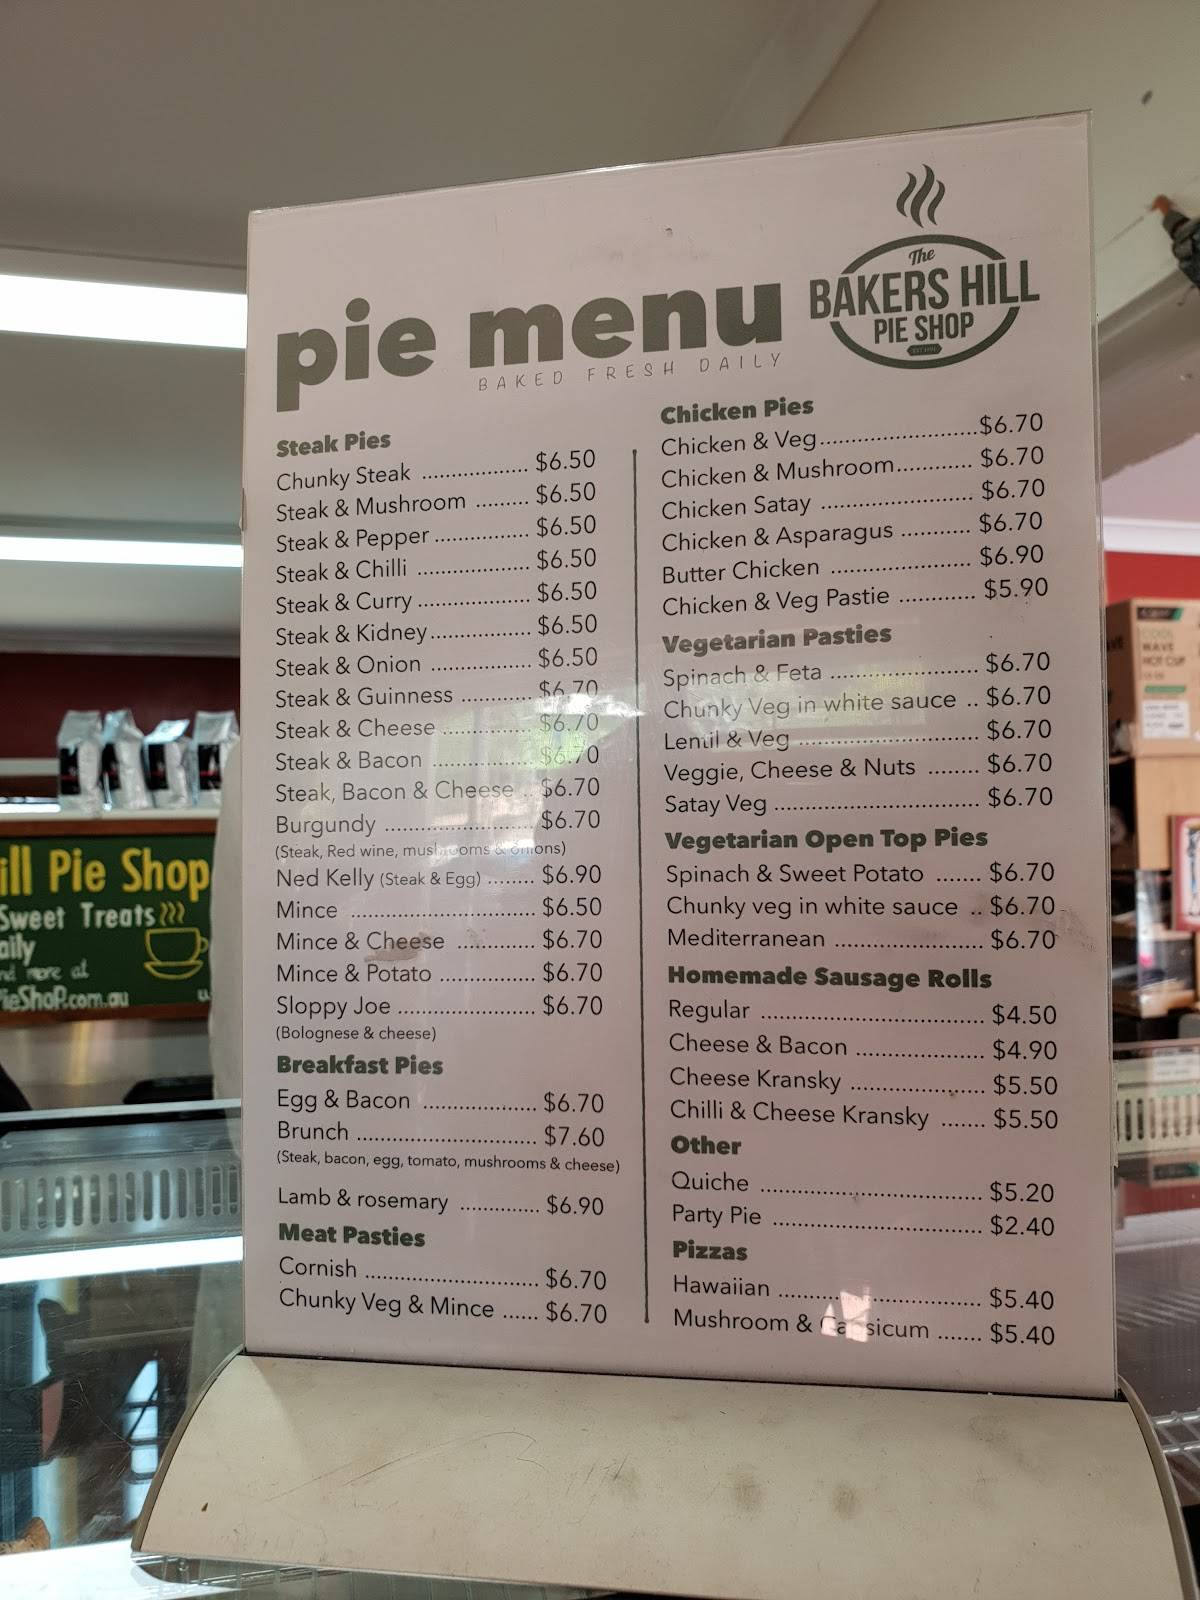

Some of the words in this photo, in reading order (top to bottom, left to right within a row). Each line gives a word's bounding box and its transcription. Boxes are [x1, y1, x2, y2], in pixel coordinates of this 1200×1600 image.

[908, 248, 936, 266] The
[809, 267, 949, 319] BAKERS
[960, 260, 1040, 307] HILL
[874, 317, 908, 344] PIE
[914, 312, 974, 341] SHOP
[277, 297, 436, 412] pie
[470, 283, 782, 369] menu
[478, 370, 563, 391] BAKED
[588, 360, 674, 382] FRESH
[700, 352, 782, 373] DAILY
[660, 402, 756, 424] Chicken
[764, 396, 814, 417] Pies
[276, 435, 338, 457] Steak
[345, 431, 391, 451] Pies
[662, 435, 745, 456] Chicken
[753, 432, 768, 450] &
[775, 430, 816, 452] Veg
[980, 412, 1043, 436] $6.70
[277, 468, 350, 491] Chunky
[356, 462, 411, 484] Steak
[536, 449, 595, 473] $6.50
[276, 500, 329, 522] Steak
[335, 499, 349, 517] &
[357, 494, 465, 516] Mushroom
[536, 482, 595, 506] $6.50
[662, 498, 746, 520] Chicken
[754, 496, 811, 516] Satay
[982, 478, 1045, 501] $6.70
[277, 531, 328, 553] Steak
[335, 530, 349, 548] &
[357, 529, 429, 551] Pepper
[536, 514, 596, 538] $6.50
[662, 530, 746, 552] Chicken
[754, 528, 770, 546] &
[776, 525, 893, 548] Asparagus
[979, 511, 1042, 534] $6.70
[663, 566, 726, 584] Butter
[733, 558, 819, 579] Chicken
[980, 544, 1043, 567] $6.90
[663, 594, 746, 616] Chicken
[755, 592, 770, 610] &
[776, 591, 818, 613] Veg
[827, 589, 889, 607] Pastie
[984, 577, 1048, 600] $5.90
[662, 629, 795, 657] Vegetarian
[804, 624, 892, 646] Pasties
[275, 656, 330, 677] Steak
[336, 656, 351, 675] &
[357, 655, 420, 674] Onion
[538, 647, 597, 669] $6.50
[664, 764, 743, 786] Veggie,
[751, 760, 832, 779] Cheese
[840, 758, 856, 777] &
[865, 757, 915, 776] Nuts
[988, 753, 1052, 775] $6.70
[665, 795, 720, 817] Satay
[726, 794, 766, 816] Veg
[988, 786, 1053, 808] $6.70
[277, 813, 376, 838] Burgundy
[541, 809, 600, 830] $6.70
[664, 829, 798, 854] Vegetarian
[805, 830, 874, 853] Open
[880, 829, 927, 852] Top
[935, 826, 988, 846] Pies
[49, 848, 106, 893] Pie
[121, 848, 210, 902] Shop
[277, 868, 318, 887] Ned
[327, 867, 374, 891] Kelly
[380, 872, 425, 888] (Steak
[430, 872, 441, 885] &
[446, 871, 480, 888] Egg)
[543, 864, 601, 885] $6.90
[667, 864, 749, 888] Spinach
[757, 864, 772, 882] &
[779, 864, 846, 882] Sweet
[854, 864, 923, 882] Potato
[990, 860, 1054, 883] $6.70
[0, 904, 65, 931] Sweet
[80, 902, 156, 928] Treats
[277, 900, 337, 918] Mince
[543, 896, 601, 918] $6.50
[667, 896, 746, 919] Chunky
[752, 902, 791, 919] veg
[800, 902, 817, 914] in
[825, 896, 885, 915] white
[893, 902, 958, 915] sauce
[990, 895, 1055, 917] $6.70
[668, 928, 824, 947] Mediterranean
[991, 928, 1055, 951] $6.70
[668, 966, 807, 985] Homemade
[814, 967, 920, 992] Sausage
[928, 968, 992, 989] Rolls
[277, 995, 347, 1020] Sloppy
[354, 996, 390, 1014] Joe
[543, 994, 602, 1016] $6.70
[669, 999, 750, 1023] Regular
[992, 1003, 1056, 1026] $4.50
[276, 1025, 359, 1043] (Bolognese
[364, 1026, 374, 1039] &
[379, 1025, 436, 1042] cheese)
[277, 1054, 389, 1074] Breakfast
[395, 1054, 443, 1075] Pies
[670, 1066, 750, 1087] Cheese
[758, 1069, 841, 1095] Kransky
[993, 1074, 1057, 1096] $5.50
[278, 1089, 317, 1113] Egg
[324, 1089, 339, 1108] &
[347, 1090, 409, 1109] Bacon
[544, 1091, 604, 1113] $6.70
[671, 1099, 722, 1119] Chilli
[731, 1101, 746, 1120] &
[753, 1101, 835, 1123] Cheese
[843, 1105, 929, 1131] Kransky
[994, 1107, 1058, 1130] $5.50
[278, 1120, 348, 1141] Brunch
[545, 1124, 604, 1147] $7.60
[671, 1135, 741, 1155] Other
[277, 1150, 320, 1166] (Steak,
[325, 1151, 369, 1166] bacon,
[373, 1156, 403, 1171] egg,
[408, 1155, 460, 1168] tomato,
[464, 1155, 546, 1169] mushrooms
[550, 1156, 560, 1170] &
[565, 1157, 619, 1174] cheese)
[279, 1187, 331, 1206] Lamb
[337, 1188, 351, 1206] &
[358, 1195, 448, 1215] rosemary
[547, 1194, 604, 1215] $6.90
[672, 1171, 748, 1191] Quiche
[990, 1181, 1054, 1203] $5.20
[279, 1223, 337, 1243] Meat
[343, 1226, 425, 1247] Pasties
[673, 1204, 723, 1229] Party
[731, 1206, 761, 1225] Pie
[990, 1214, 1054, 1236] $2.40
[673, 1239, 748, 1261] Pizzas
[279, 1256, 356, 1278] Cornish
[546, 1267, 606, 1290] $6.70
[280, 1288, 356, 1315] Chunky
[361, 1292, 401, 1318] Veg
[409, 1294, 424, 1314] &
[431, 1296, 494, 1318] Mince
[546, 1300, 607, 1324] $6.70
[674, 1274, 769, 1296] Hawaiian
[990, 1287, 1054, 1310] $5.40
